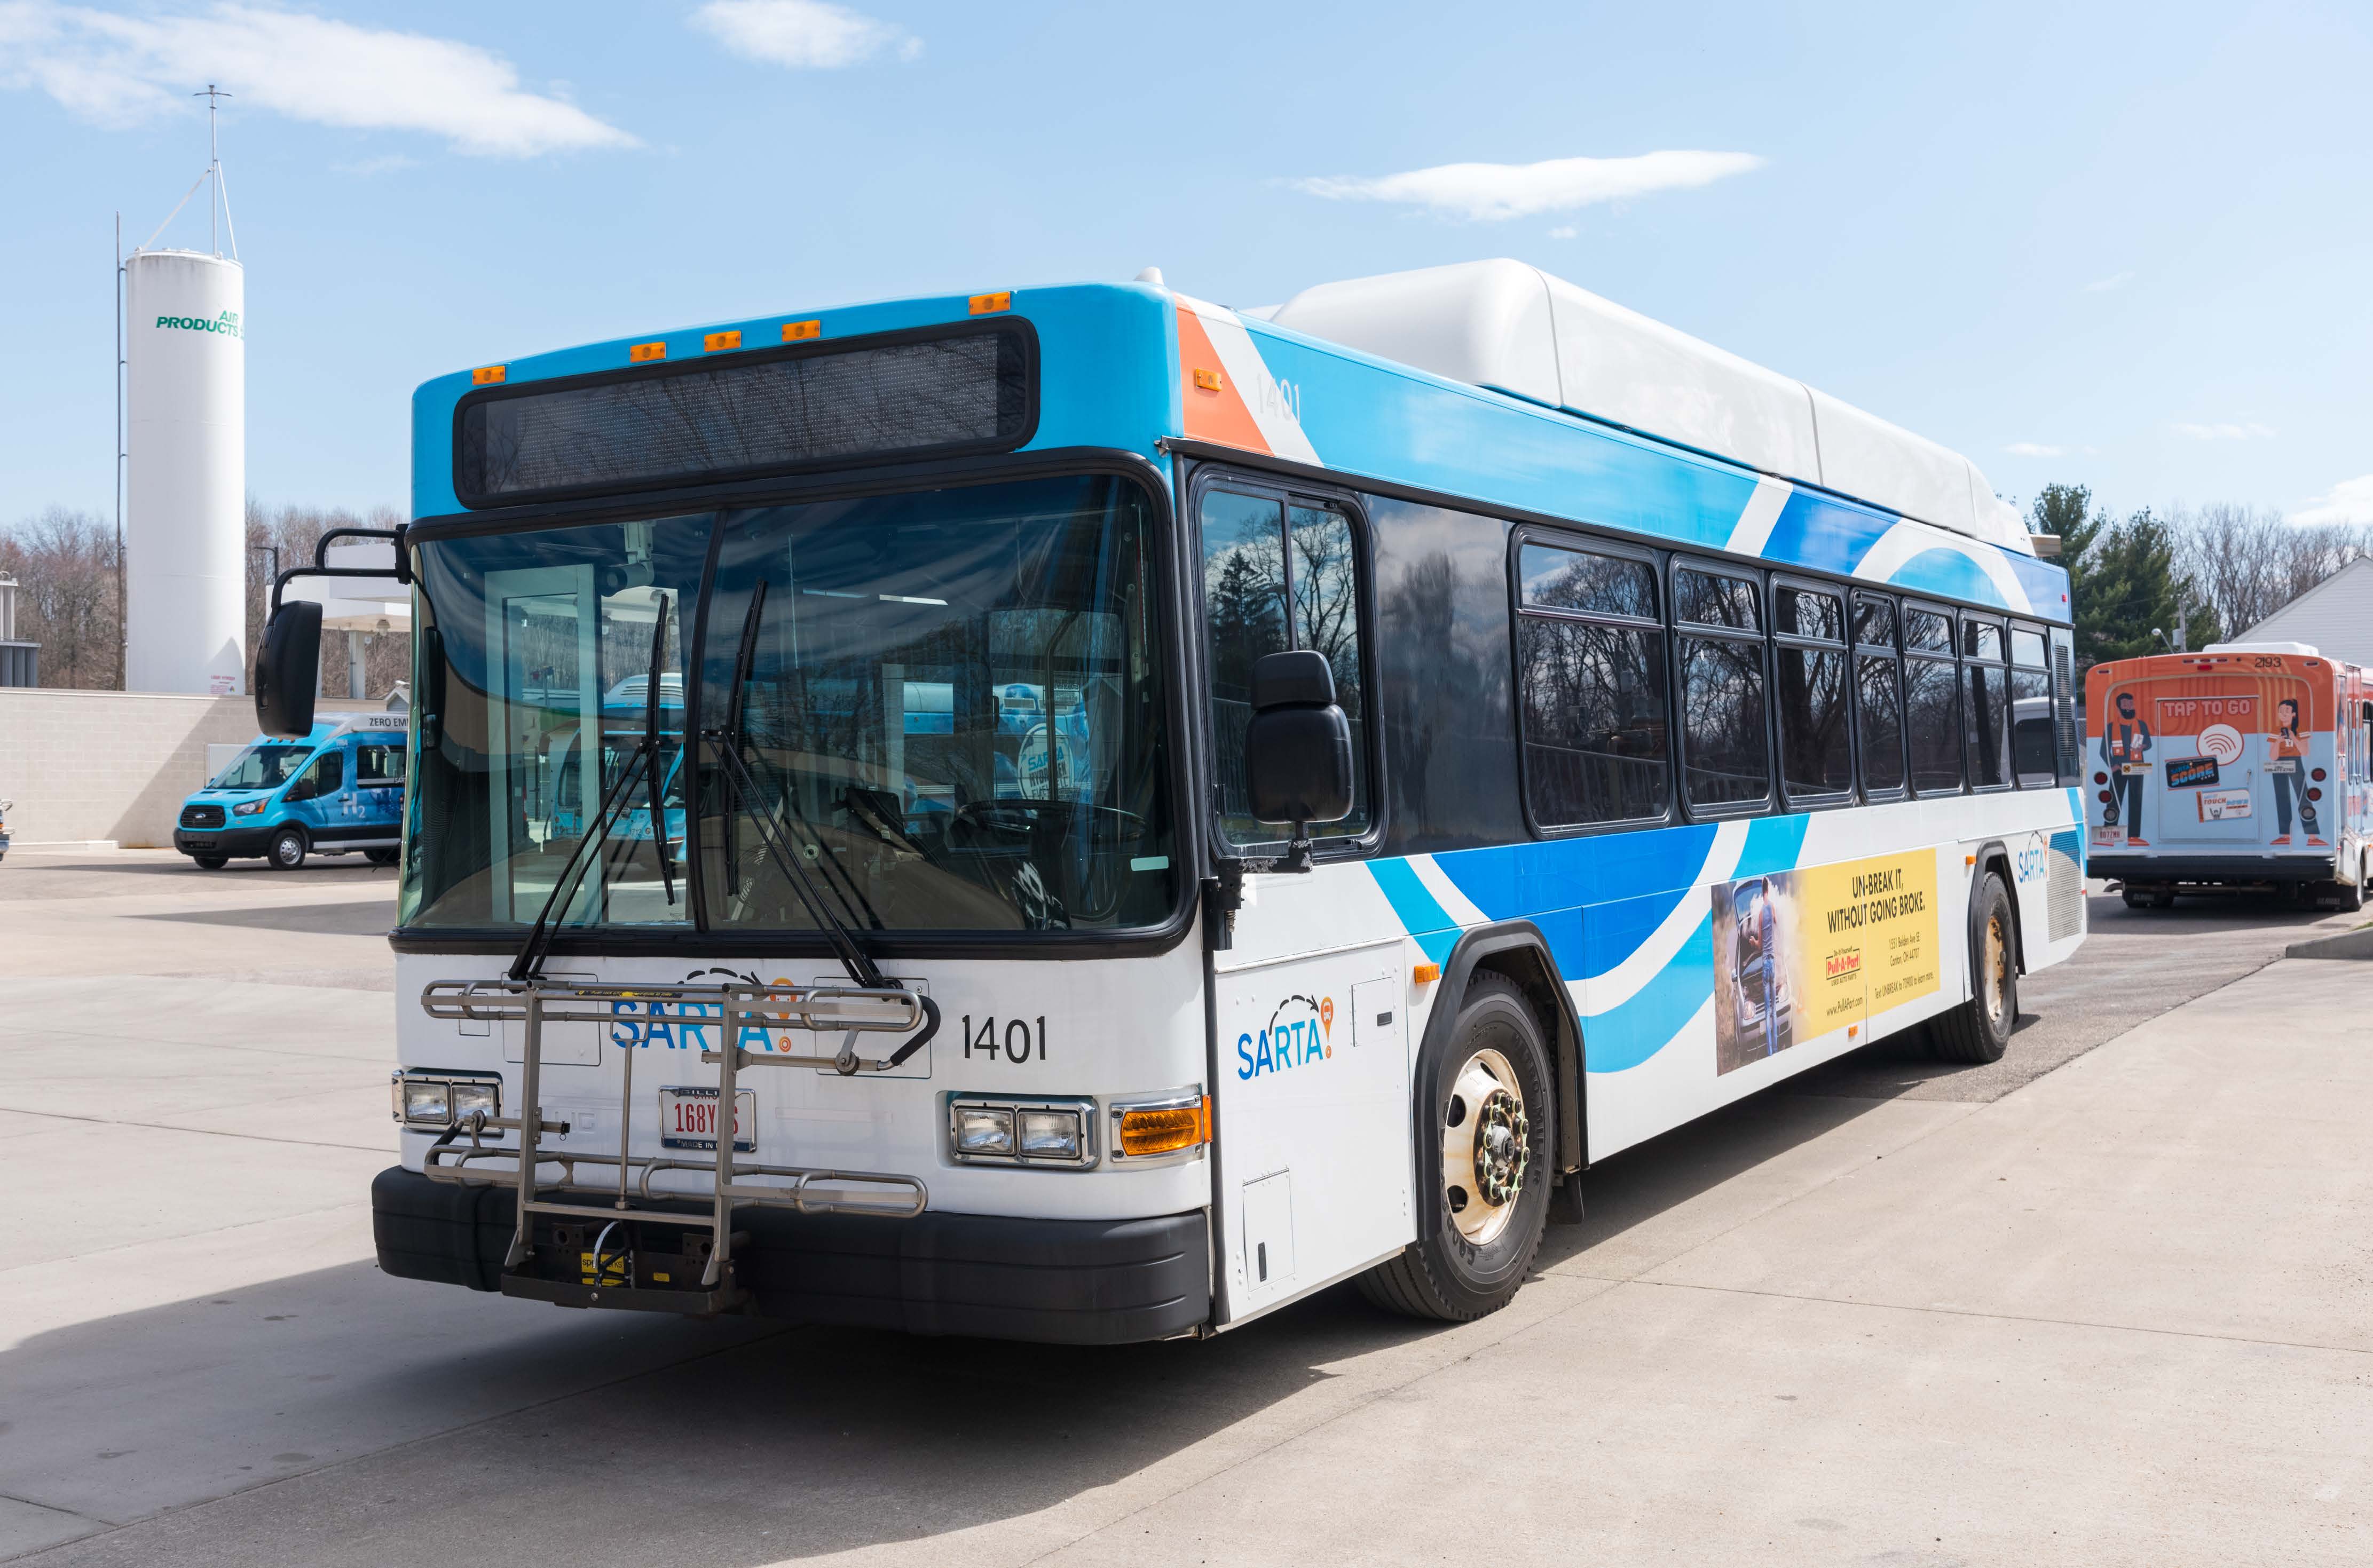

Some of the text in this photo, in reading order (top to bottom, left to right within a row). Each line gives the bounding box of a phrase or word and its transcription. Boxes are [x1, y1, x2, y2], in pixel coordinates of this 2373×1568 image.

[156, 316, 238, 337] PRODUCTS
[219, 310, 238, 324] AIR
[1257, 373, 1300, 425] 1401
[2254, 657, 2281, 668] 2193
[2164, 699, 2250, 717] TAP TO GO
[369, 718, 391, 726] ZERO
[2171, 762, 2213, 786] SCORE
[1895, 868, 1904, 892] IT,
[1827, 891, 1925, 933] WITHOUT GOING BROKE.
[1889, 938, 1897, 951] 1551
[1898, 935, 1909, 948] Belden
[1903, 951, 1909, 962] OH
[1909, 948, 1920, 960] 44707
[1831, 978, 1839, 986] USED
[1848, 973, 1857, 982] PARTS
[1882, 981, 1898, 996] UNBREAK
[1899, 981, 1902, 991] to
[1913, 977, 1917, 985] to
[1826, 996, 1863, 1016] www.PullAPart.com
[962, 1015, 1046, 1064] 1401
[675, 1103, 738, 1135] 168YS
